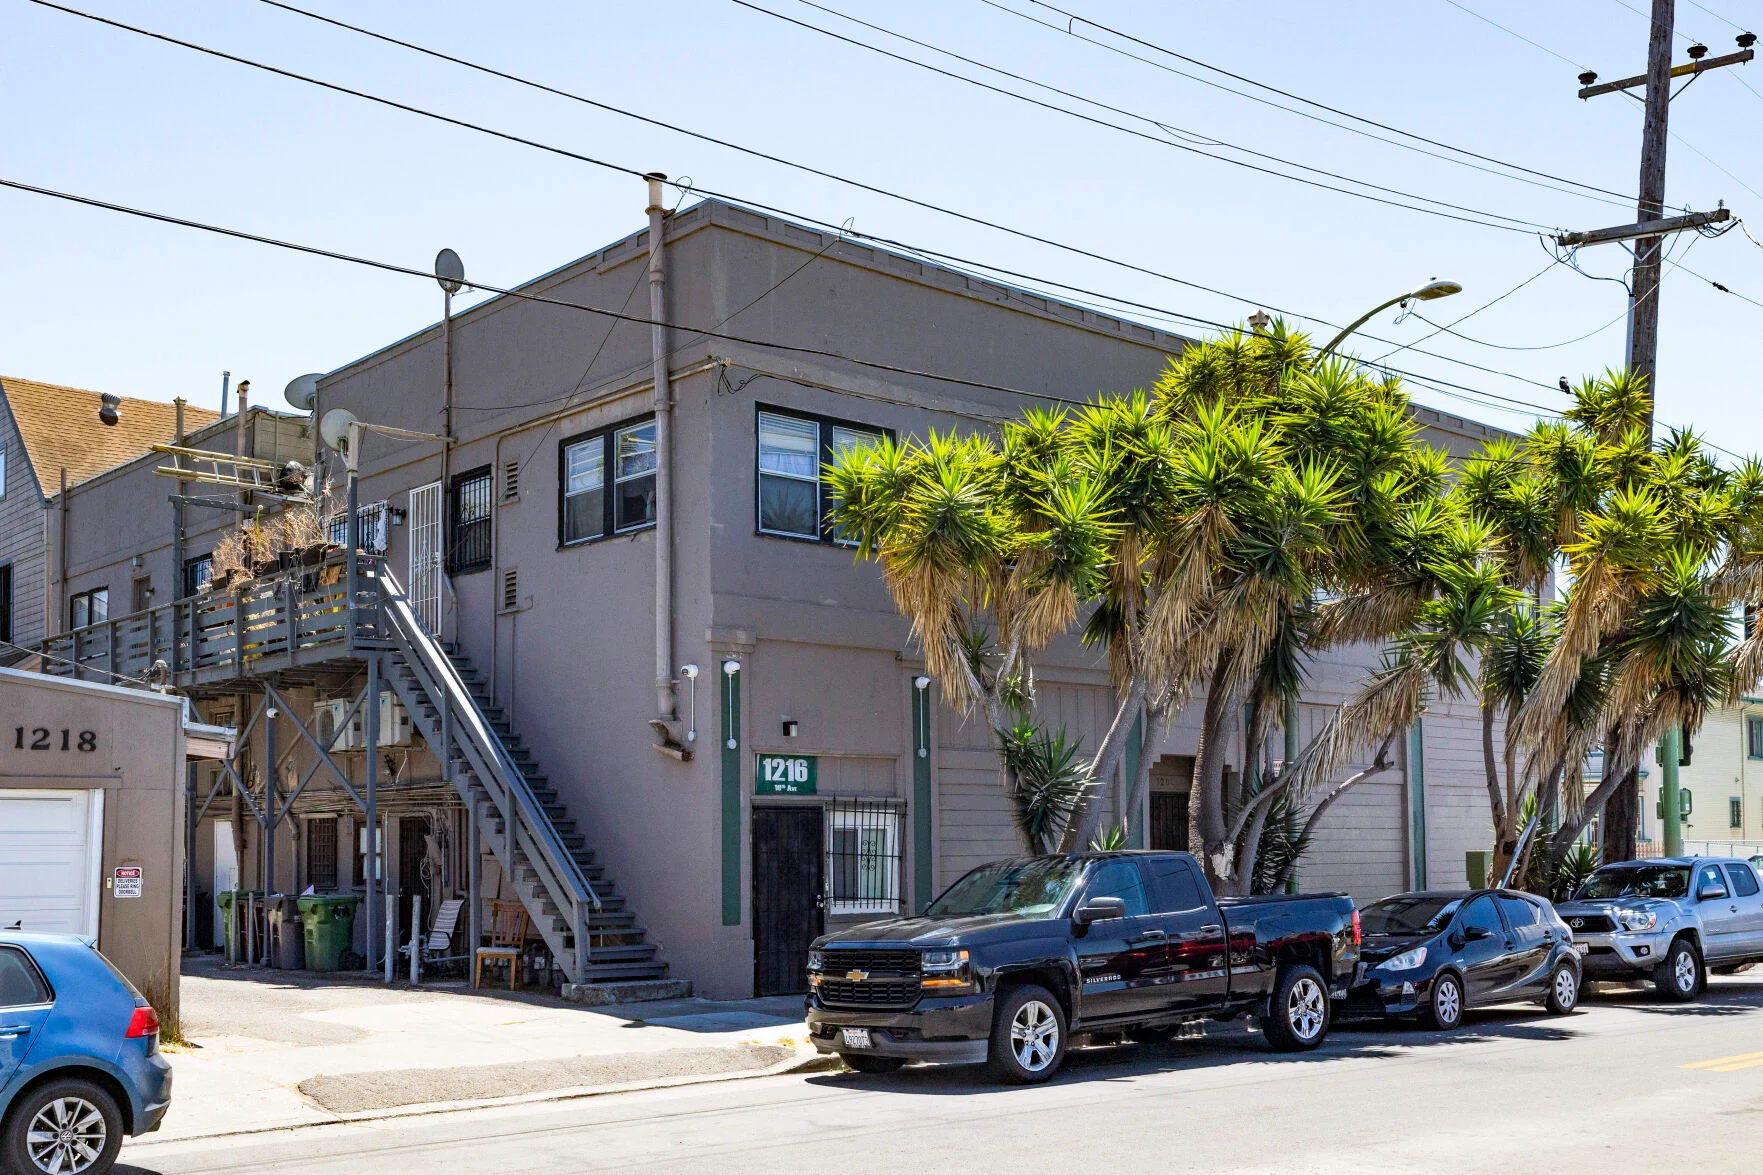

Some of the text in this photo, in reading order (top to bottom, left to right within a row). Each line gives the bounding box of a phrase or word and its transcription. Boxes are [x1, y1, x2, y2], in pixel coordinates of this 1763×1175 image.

[14, 726, 97, 752] 1218
[763, 758, 808, 782] 1216
[1086, 974, 1122, 984] SILVERADO
